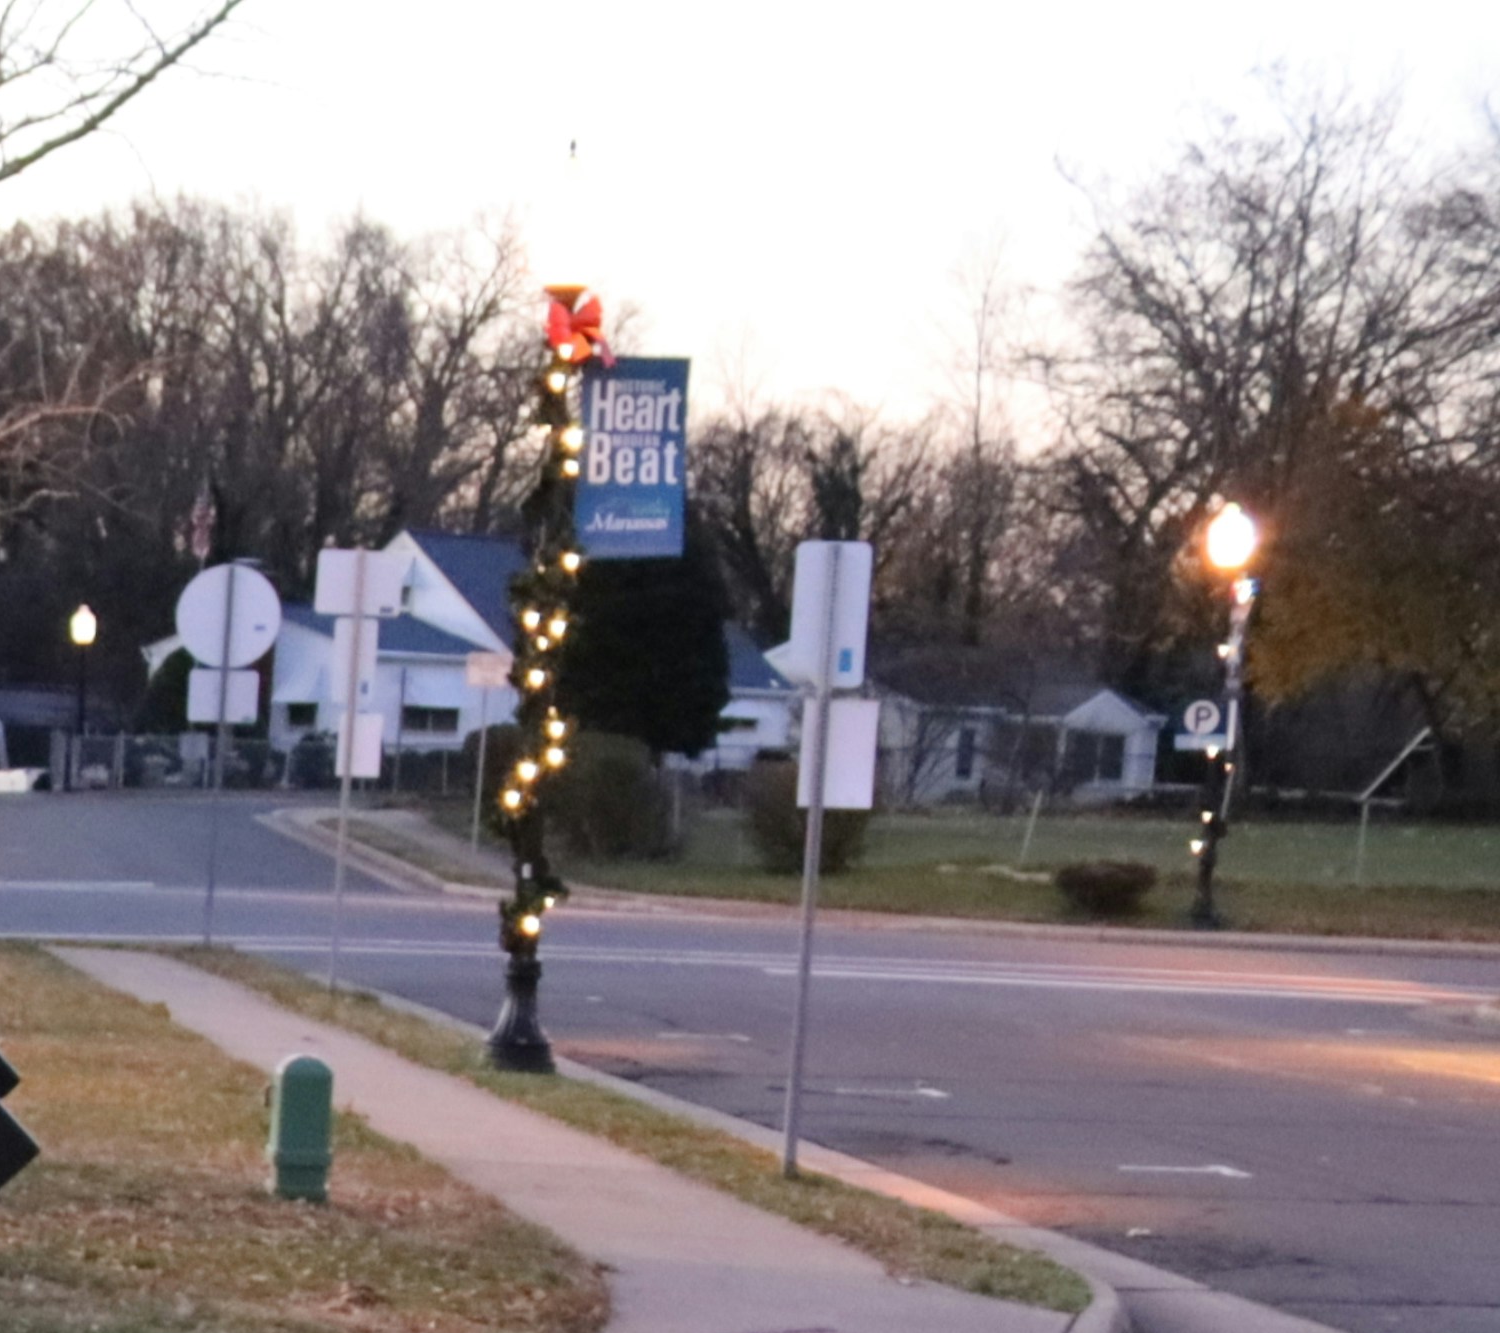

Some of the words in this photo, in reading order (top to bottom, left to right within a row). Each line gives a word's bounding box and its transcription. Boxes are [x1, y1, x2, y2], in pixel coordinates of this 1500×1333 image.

[591, 379, 681, 433] Heart
[587, 432, 679, 485] Beat
[1194, 705, 1212, 730] P
